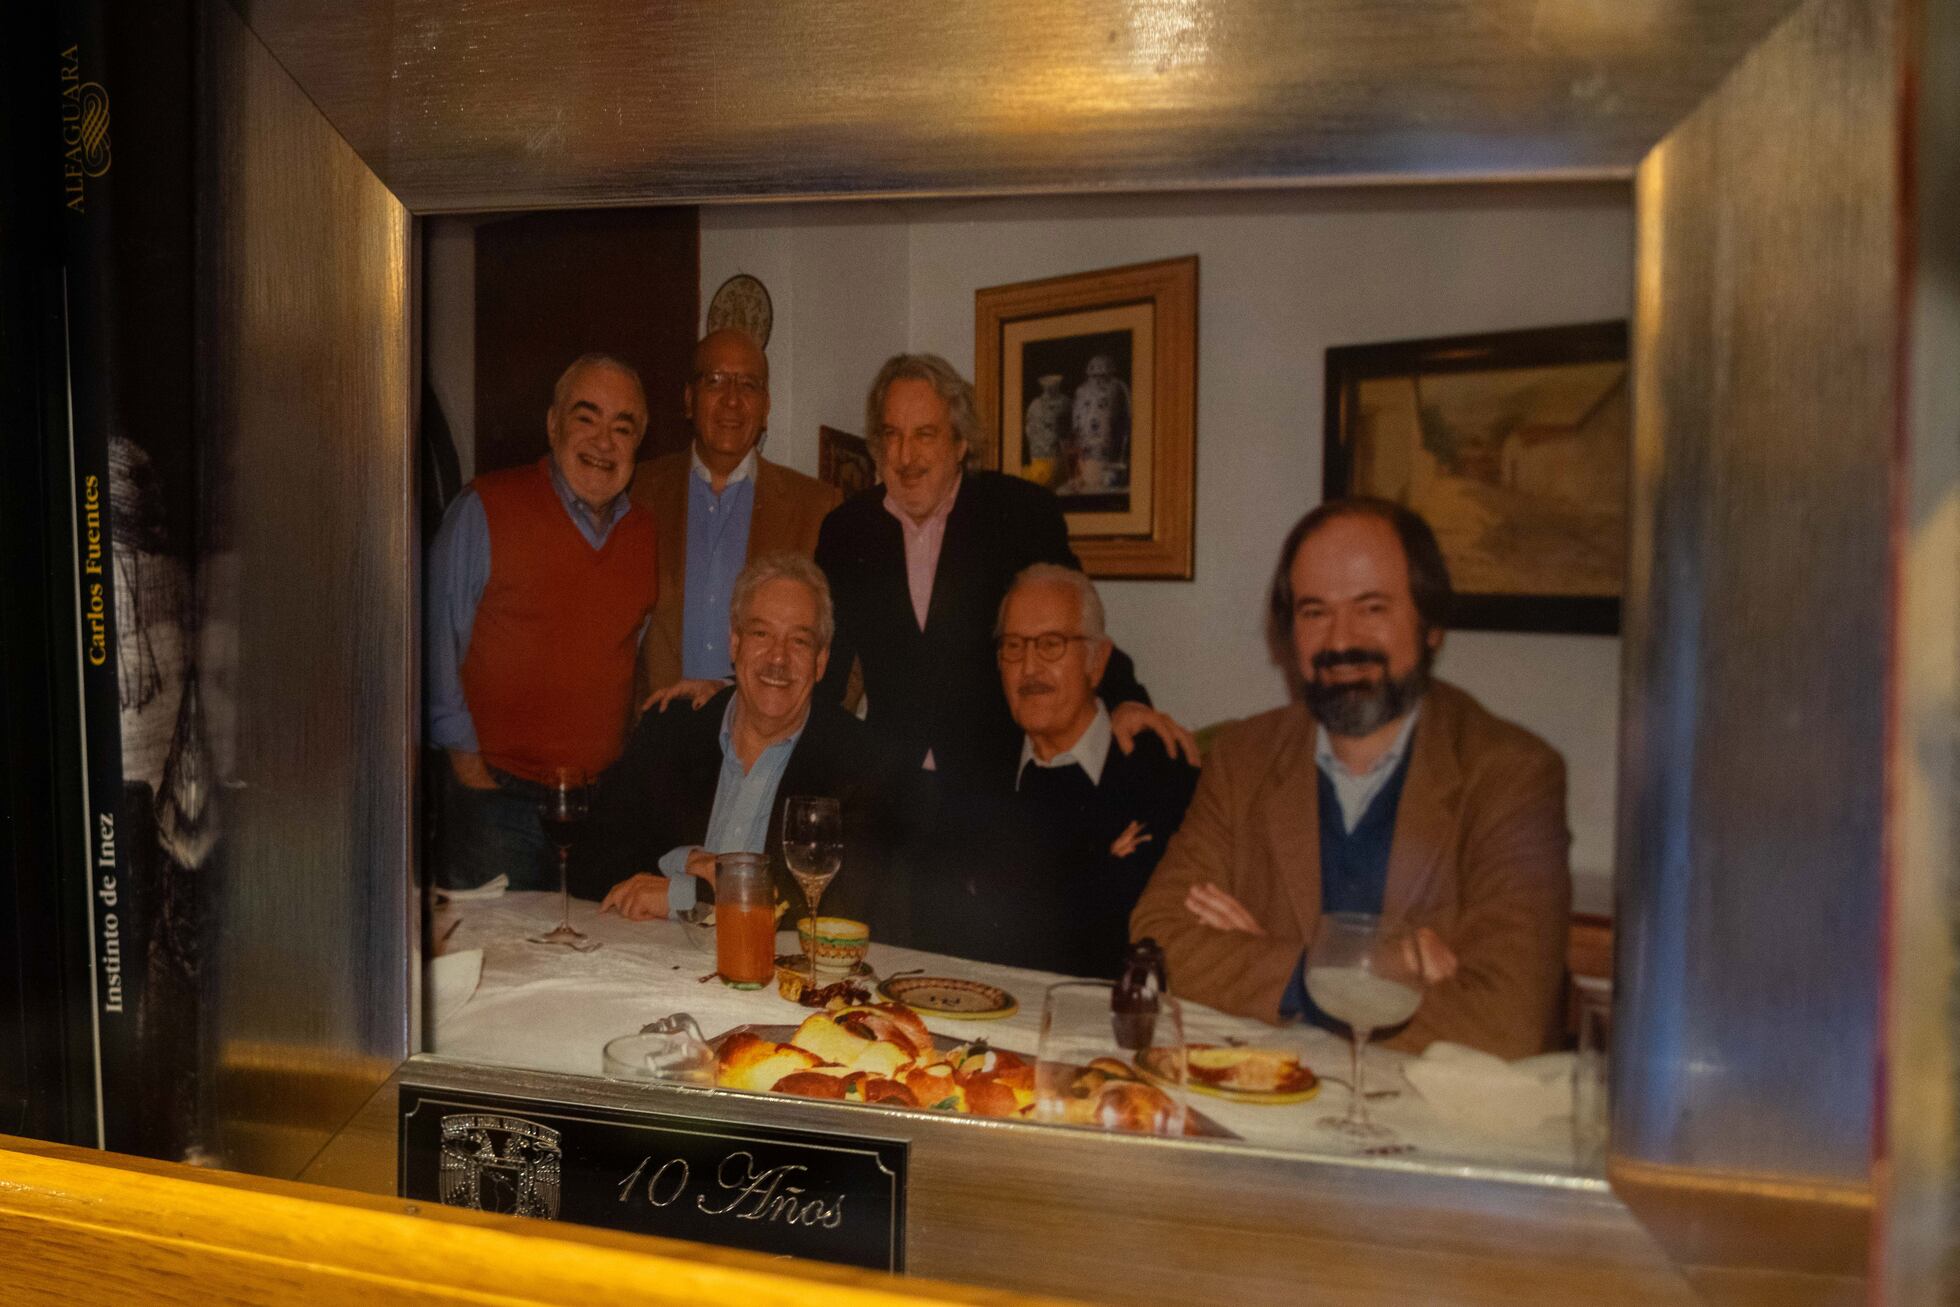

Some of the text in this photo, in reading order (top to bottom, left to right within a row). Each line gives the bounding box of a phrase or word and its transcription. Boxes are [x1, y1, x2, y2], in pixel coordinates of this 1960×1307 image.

[61, 44, 85, 214] ALFAGUARA
[84, 475, 107, 666] Carlos Fuentes
[98, 812, 123, 1014] Instinto de Inez
[617, 1151, 845, 1229] 10 Años
